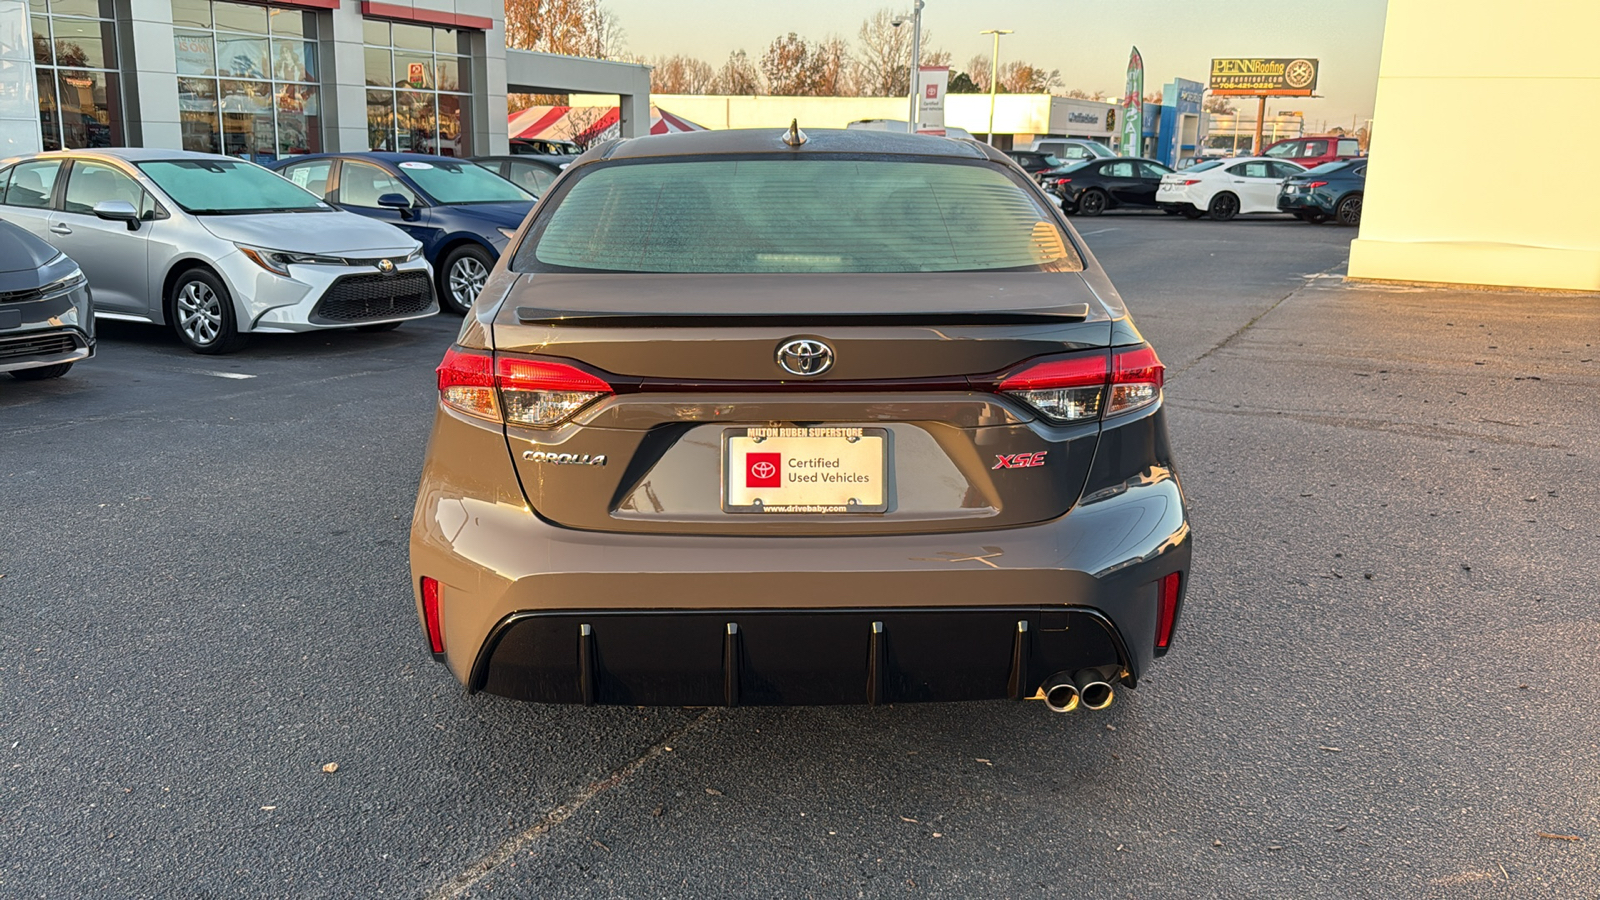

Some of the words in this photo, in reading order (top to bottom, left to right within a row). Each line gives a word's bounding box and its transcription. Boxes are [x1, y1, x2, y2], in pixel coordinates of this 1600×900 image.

[1212, 59, 1258, 74] PENN
[1255, 61, 1285, 76] Roofing
[747, 428, 778, 438] MILTON
[779, 428, 808, 438] RUBEN
[808, 428, 863, 438] SUPERSTORE
[522, 450, 608, 467] COROLLA
[788, 457, 840, 469] Certified
[991, 450, 1048, 470] XSE
[788, 472, 818, 483] Used
[821, 472, 870, 483] Vehicles
[763, 504, 847, 514] www.drivebaby.com
